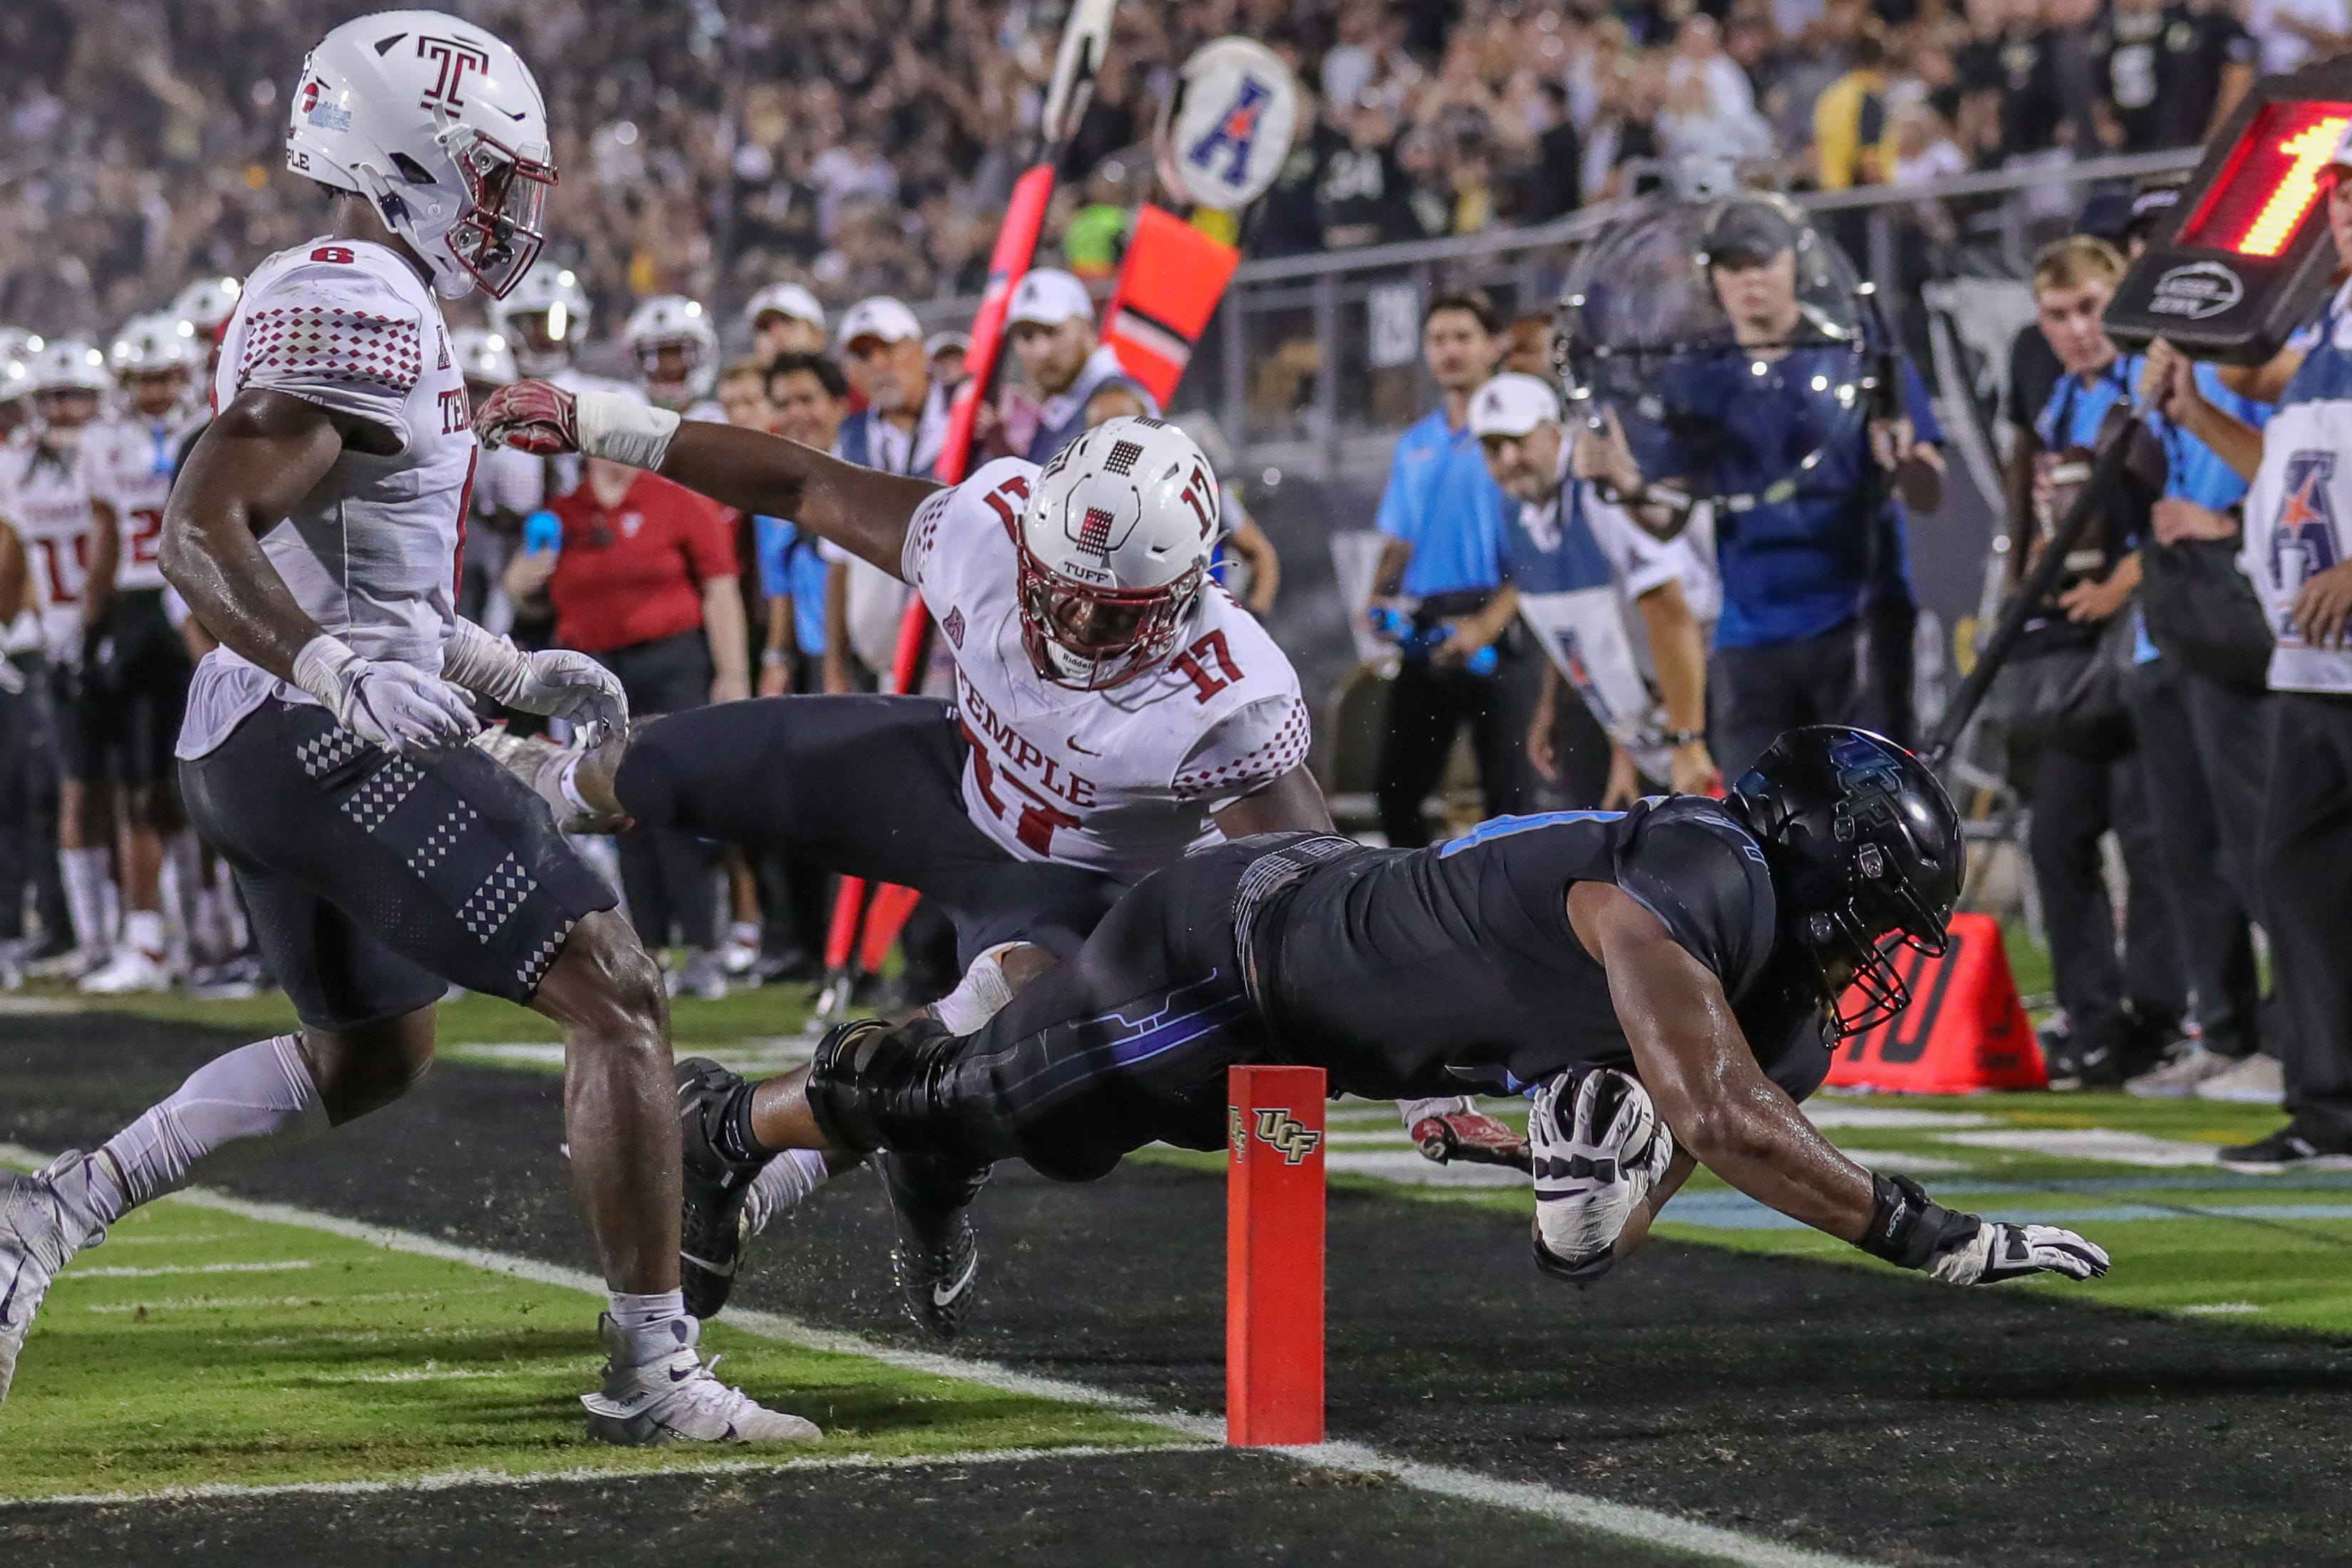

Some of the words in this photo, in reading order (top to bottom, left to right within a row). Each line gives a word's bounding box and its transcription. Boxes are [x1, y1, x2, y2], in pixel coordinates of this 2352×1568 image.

[416, 35, 490, 119] T
[2239, 117, 2350, 255] 1
[310, 247, 355, 264] 6
[1064, 561, 1109, 583] TUFF
[1168, 628, 1245, 705] 17
[1252, 1108, 1322, 1165] UCF
